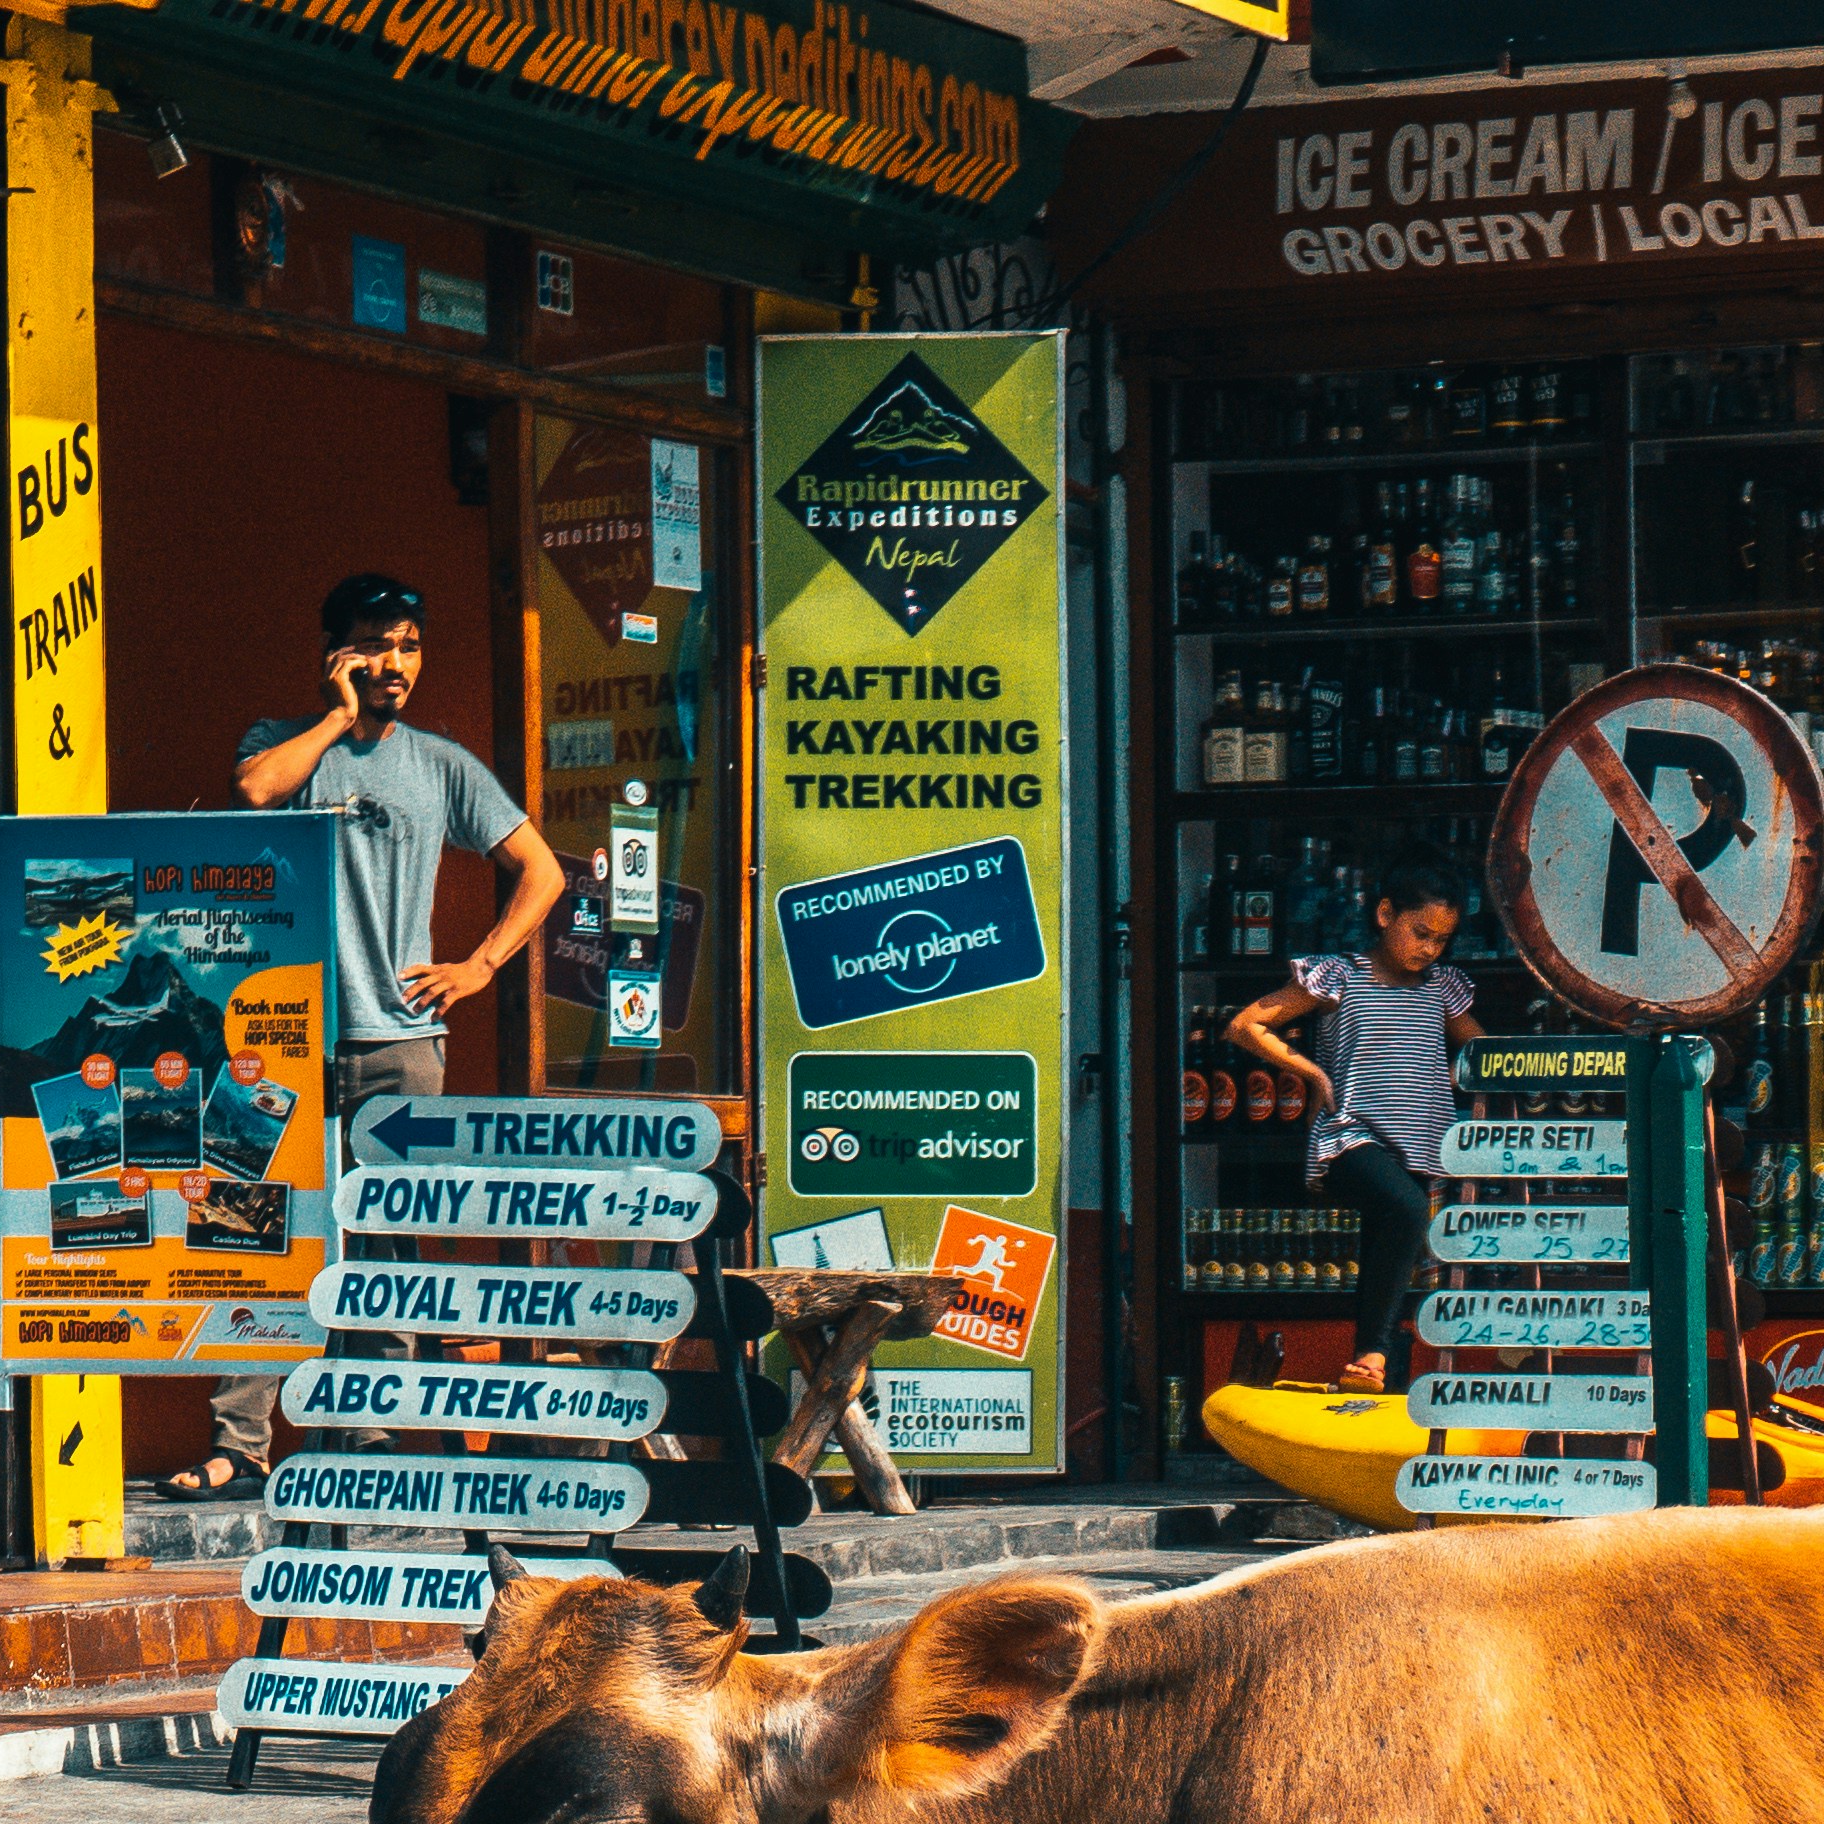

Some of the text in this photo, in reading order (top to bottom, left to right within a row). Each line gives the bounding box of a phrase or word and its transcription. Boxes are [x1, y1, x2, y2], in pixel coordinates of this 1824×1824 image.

[1276, 130, 1374, 214] ICE
[1387, 108, 1636, 206] CREAM
[1702, 94, 1824, 184] ICE
[1281, 209, 1574, 277] GROCERY
[18, 423, 93, 541] BUS
[797, 474, 1028, 509] Rapidrunner
[806, 505, 1018, 531] Expeditions
[865, 537, 962, 582] Nepal
[20, 566, 98, 681] TRAIN
[787, 666, 1002, 700] RAFTING
[49, 703, 74, 760] &
[787, 719, 1040, 754] KAYAKING
[786, 774, 1042, 808] TREKKING
[1601, 727, 1746, 956] P
[792, 855, 1005, 921] RECOMMENDED BY
[206, 910, 293, 934] flightseeing
[183, 946, 270, 968] Himalayas
[832, 922, 1001, 980] lonely planet
[231, 999, 309, 1016] Book now!
[269, 1032, 308, 1045] SPECIAL
[1481, 1052, 1626, 1077] UPCOMING DEPAR
[803, 1090, 1020, 1110] RECOMMENDED ON
[466, 1111, 697, 1160] TREKKING
[1458, 1126, 1594, 1151] UPPER SETI
[1558, 1157, 1582, 1171] &
[356, 1179, 701, 1228] PONY TREK Day
[1467, 1235, 1572, 1259] 23 25
[335, 1272, 461, 1321] ROYAL
[477, 1279, 582, 1326] TREK
[590, 1290, 623, 1316] 4-5
[626, 1291, 679, 1321] Days
[952, 1289, 1026, 1328] OUGH
[304, 1372, 649, 1427] ABC TREK 8-10 Days
[889, 1381, 920, 1396] THE
[1430, 1380, 1647, 1405] KARNALI 10 Days
[888, 1413, 1025, 1431] ecotourism
[890, 1398, 1024, 1414] INTERNATIONAL
[888, 1431, 959, 1447] SOCIETY
[275, 1466, 626, 1516] GHOREPANI TREK 4-6 Days
[1411, 1462, 1559, 1488] KAYAK CLINIC
[1459, 1489, 1565, 1512] Everyday
[250, 1561, 490, 1610] JOMSOM TREK
[244, 1671, 320, 1714] UPPER
[322, 1678, 431, 1721] MUSTANG
